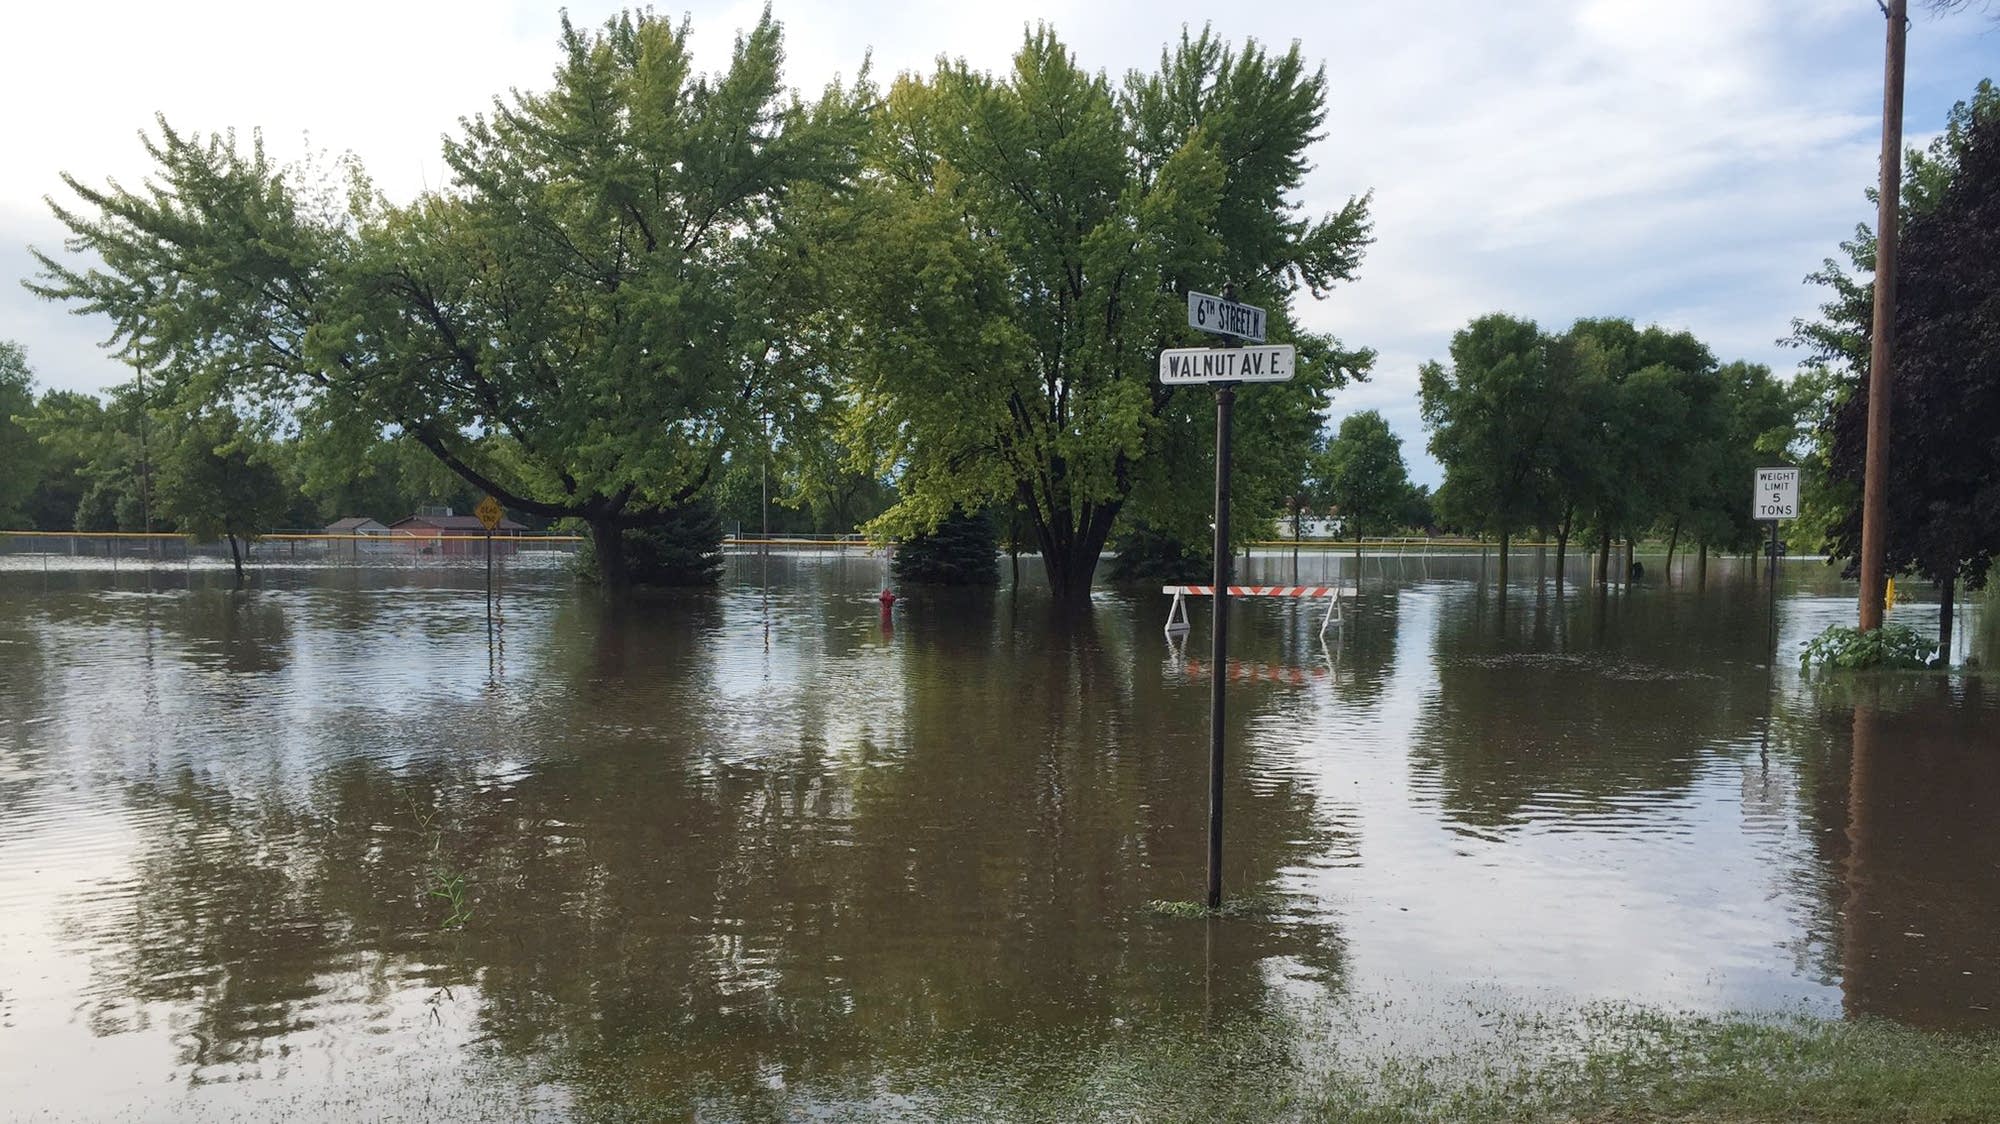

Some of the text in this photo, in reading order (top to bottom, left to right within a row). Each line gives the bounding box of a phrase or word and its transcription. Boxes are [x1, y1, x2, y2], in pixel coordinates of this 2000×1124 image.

[1197, 299, 1215, 326] 6TH
[1218, 302, 1251, 336] STREET
[1169, 352, 1285, 378] WALNUT AV. E.
[1760, 472, 1796, 480] WEIGHT
[1764, 482, 1789, 491] LIMIT
[1772, 493, 1781, 503] 5
[1760, 505, 1792, 515] TONS
